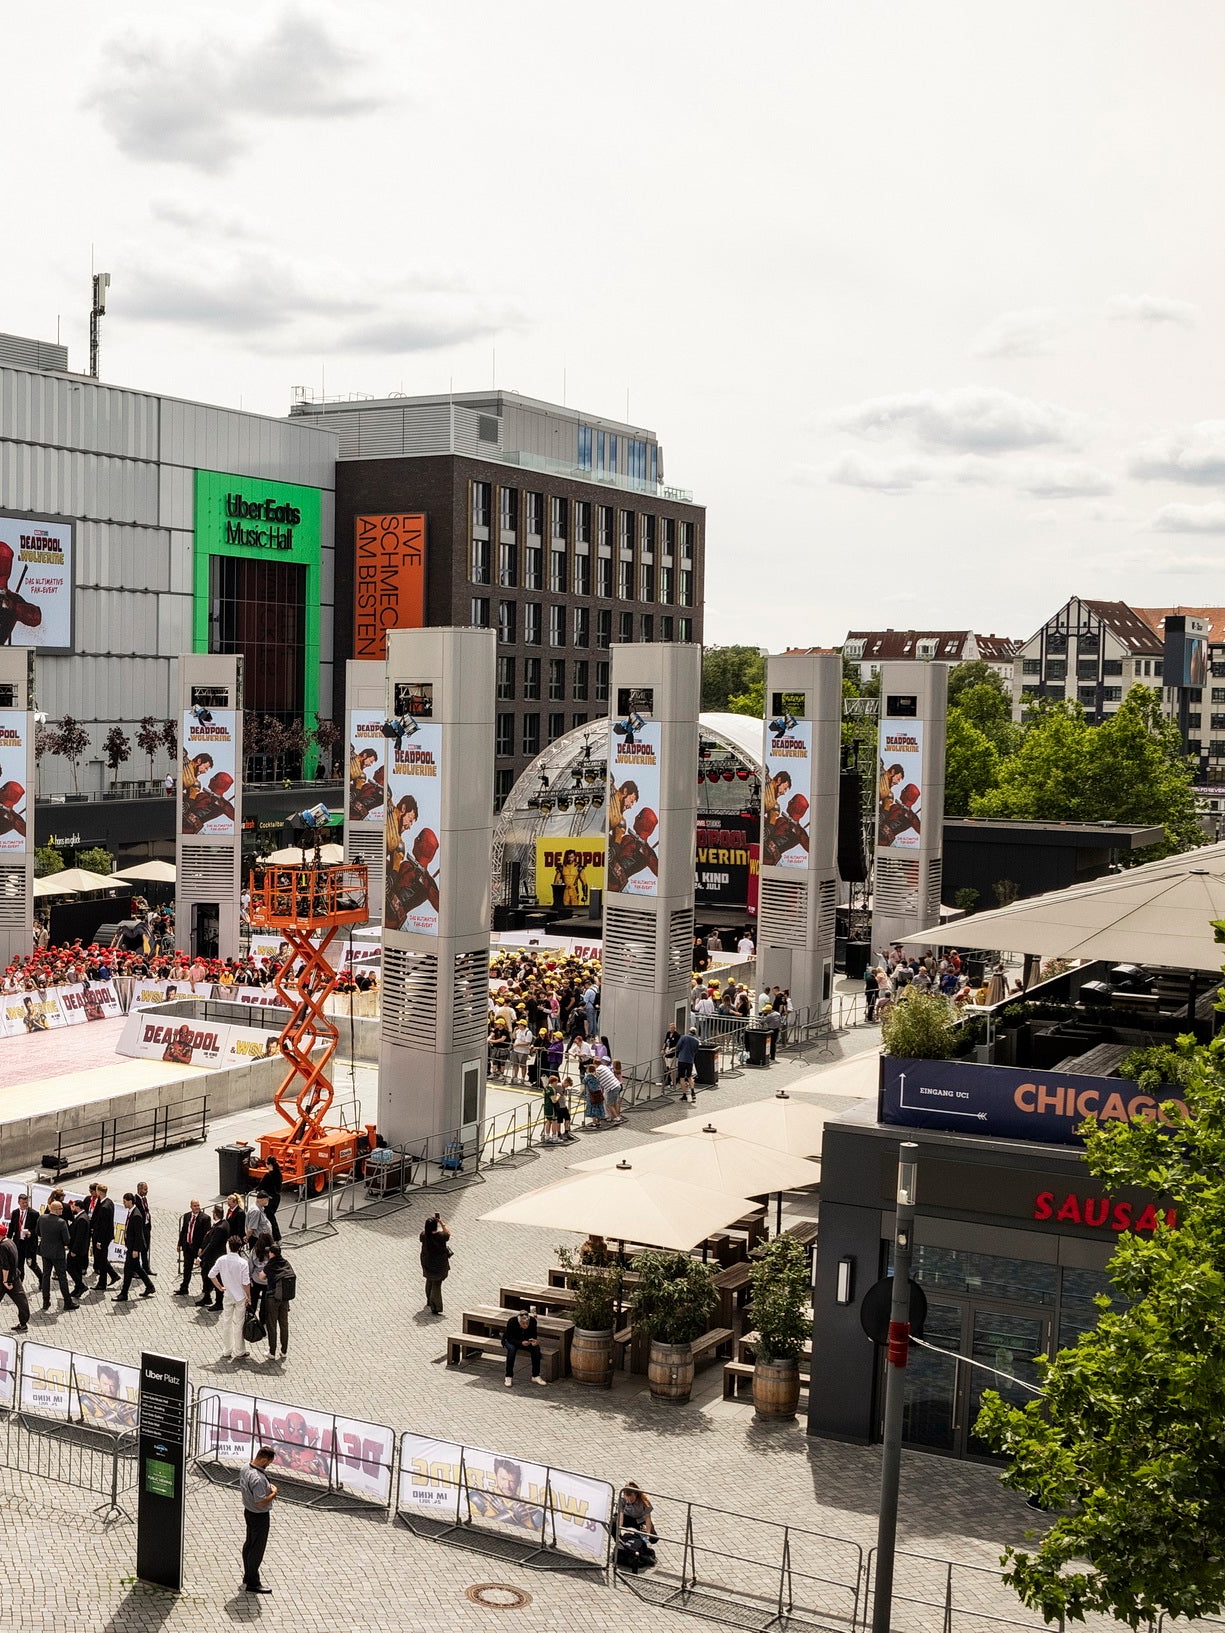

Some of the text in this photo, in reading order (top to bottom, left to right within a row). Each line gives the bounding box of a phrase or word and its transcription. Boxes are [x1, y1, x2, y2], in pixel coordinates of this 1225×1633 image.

[227, 493, 301, 525] Uber Eats
[226, 521, 293, 550] Music Hall
[402, 516, 421, 567] LIVE
[20, 535, 62, 552] DEADPOOL
[357, 518, 376, 655] AM BESTEN
[379, 516, 399, 652] SCHMEC
[190, 726, 229, 734] DEADPOOL
[357, 724, 384, 732] DEADPO
[771, 739, 807, 750] DEADPOOL
[886, 736, 918, 746] DEADPOOL
[617, 743, 655, 755] DEADPOOL
[394, 750, 435, 764] DEADPOOL
[702, 872, 729, 883] KINO
[920, 1088, 953, 1097] EINGANG
[145, 1369, 180, 1385] Uber Platz
